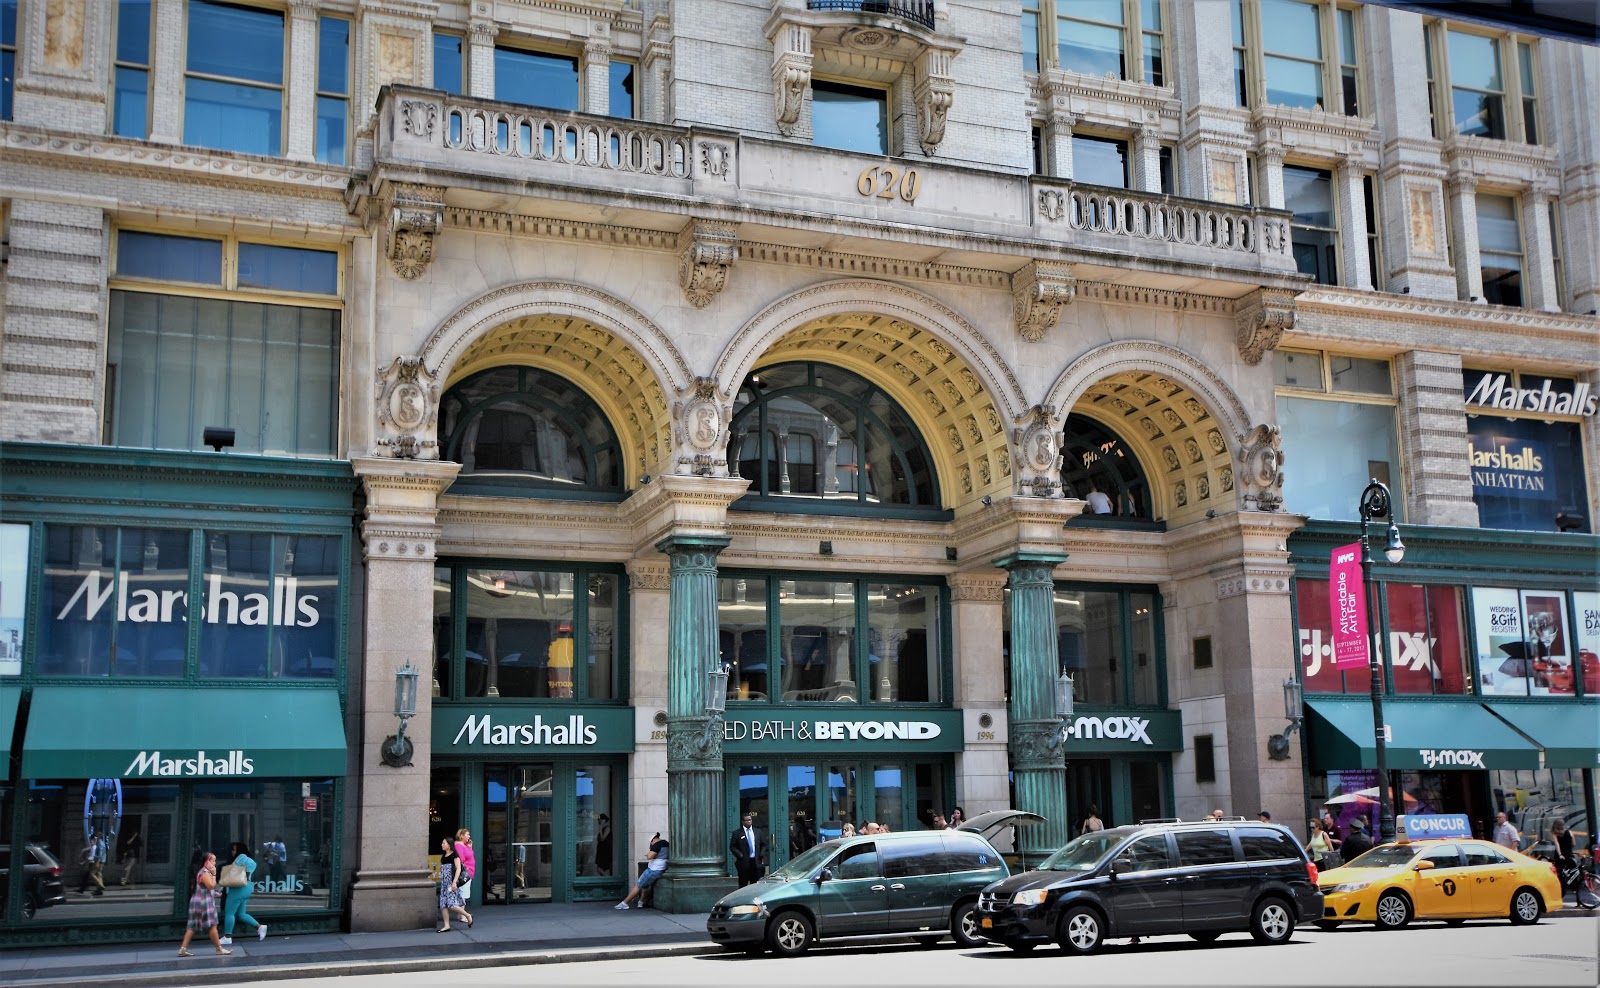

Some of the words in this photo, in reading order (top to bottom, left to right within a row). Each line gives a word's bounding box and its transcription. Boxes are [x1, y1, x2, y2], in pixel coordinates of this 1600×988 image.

[857, 166, 920, 202] 620
[1465, 373, 1599, 417] Marshalls
[1337, 552, 1355, 564] NYC
[1337, 572, 1350, 635] Affordable
[1347, 593, 1357, 613] Fair
[1489, 606, 1517, 614] WEDDING
[1349, 614, 1359, 633] Art
[1336, 640, 1362, 648] SEPTEMBER
[452, 714, 598, 745] Marshalls
[721, 720, 747, 741] ED
[752, 720, 795, 740] BATH
[797, 720, 812, 740] &
[814, 721, 942, 740] BEYOND
[976, 731, 995, 741] 1996
[123, 750, 254, 776] Marshalls
[1410, 817, 1466, 832] CONCUR
